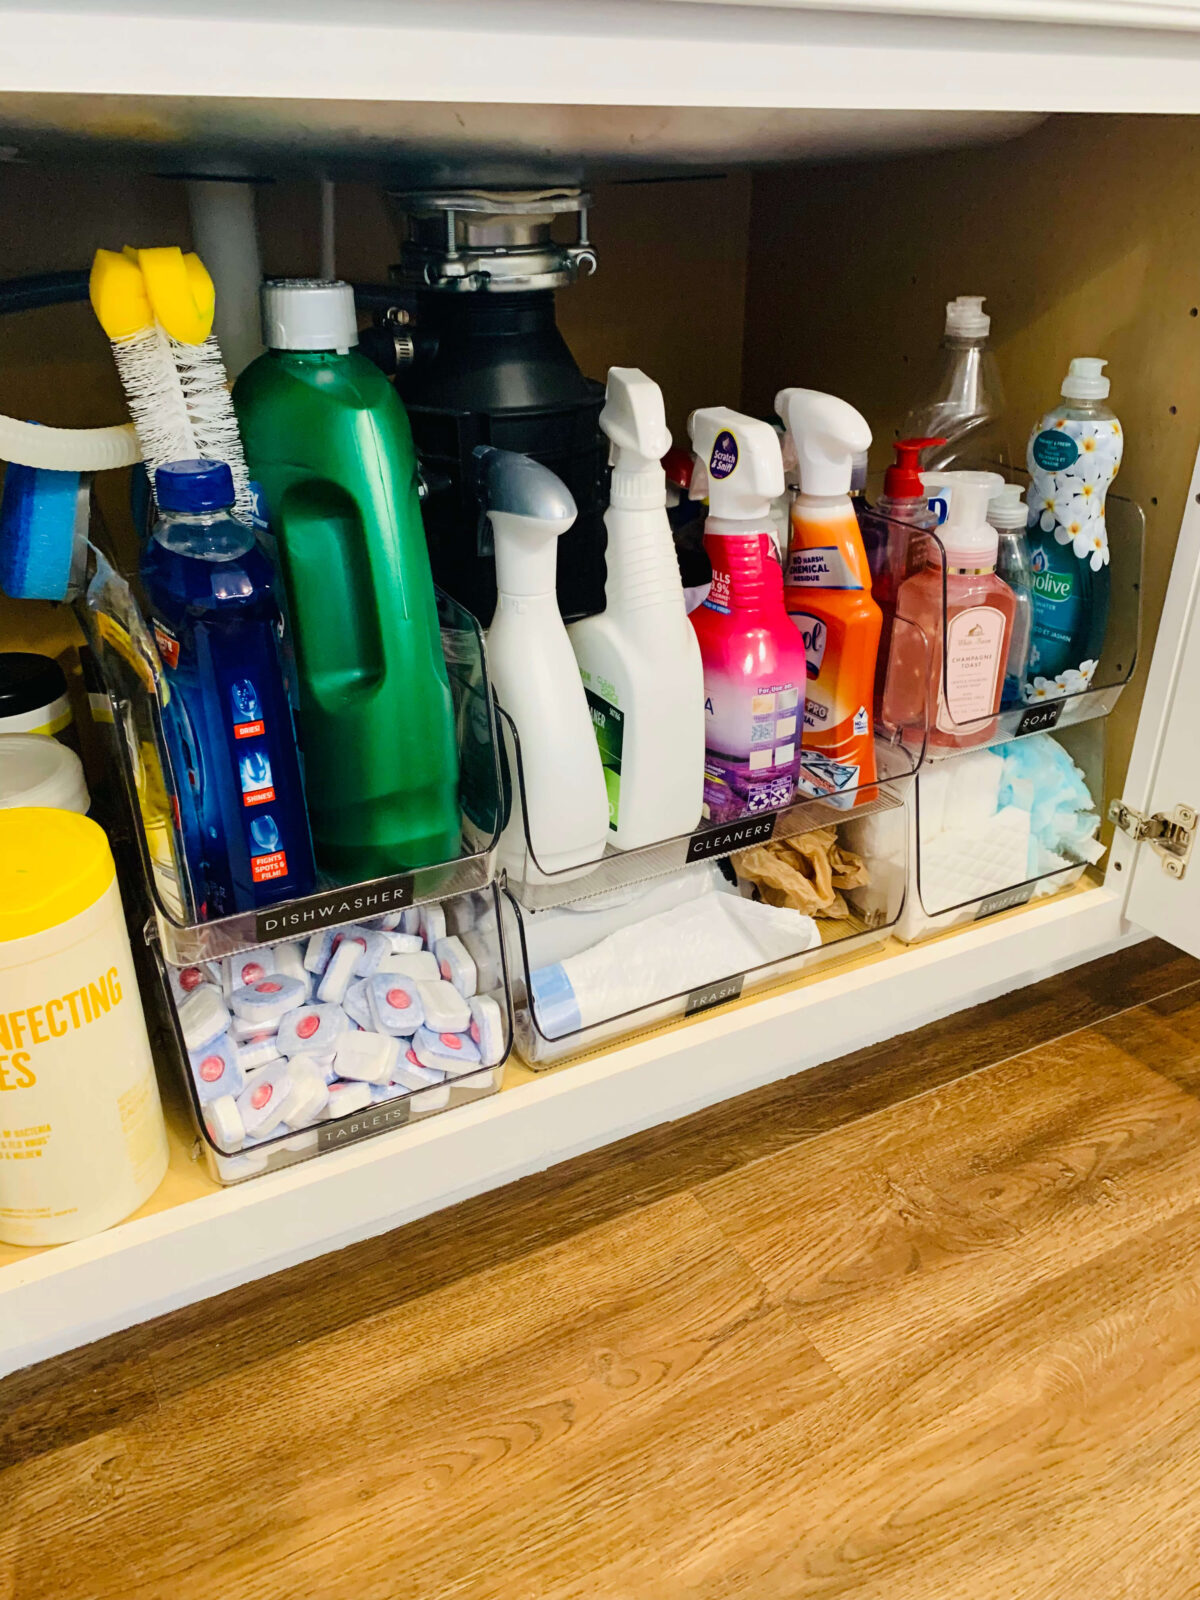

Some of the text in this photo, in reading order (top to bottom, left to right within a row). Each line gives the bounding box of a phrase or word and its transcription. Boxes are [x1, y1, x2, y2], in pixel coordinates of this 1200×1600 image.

[714, 450, 736, 464] Scratch
[711, 459, 733, 473] & Sniff
[803, 556, 824, 564] HARSH
[790, 564, 830, 574] CHEMICAL
[1032, 573, 1071, 597] olive
[1051, 631, 1072, 642] JASMIN
[952, 654, 992, 664] CHAMPAGNE
[961, 661, 982, 669] TOAST
[807, 700, 827, 718] PRO
[1022, 711, 1057, 727] SOAP
[239, 725, 261, 735] DRIES!
[246, 791, 273, 803] SHINES!
[693, 823, 771, 852] CLEANERS
[256, 854, 282, 865] FIGHTS
[255, 864, 279, 873] SPOTS
[261, 870, 282, 880] FILM!
[980, 891, 1030, 913] SWIFFER
[265, 888, 404, 931] DISHWASHER
[692, 985, 736, 1008] TRASH
[0, 966, 123, 1050] NFECTING
[0, 1052, 37, 1091] ES
[325, 1109, 401, 1141] TABLETS
